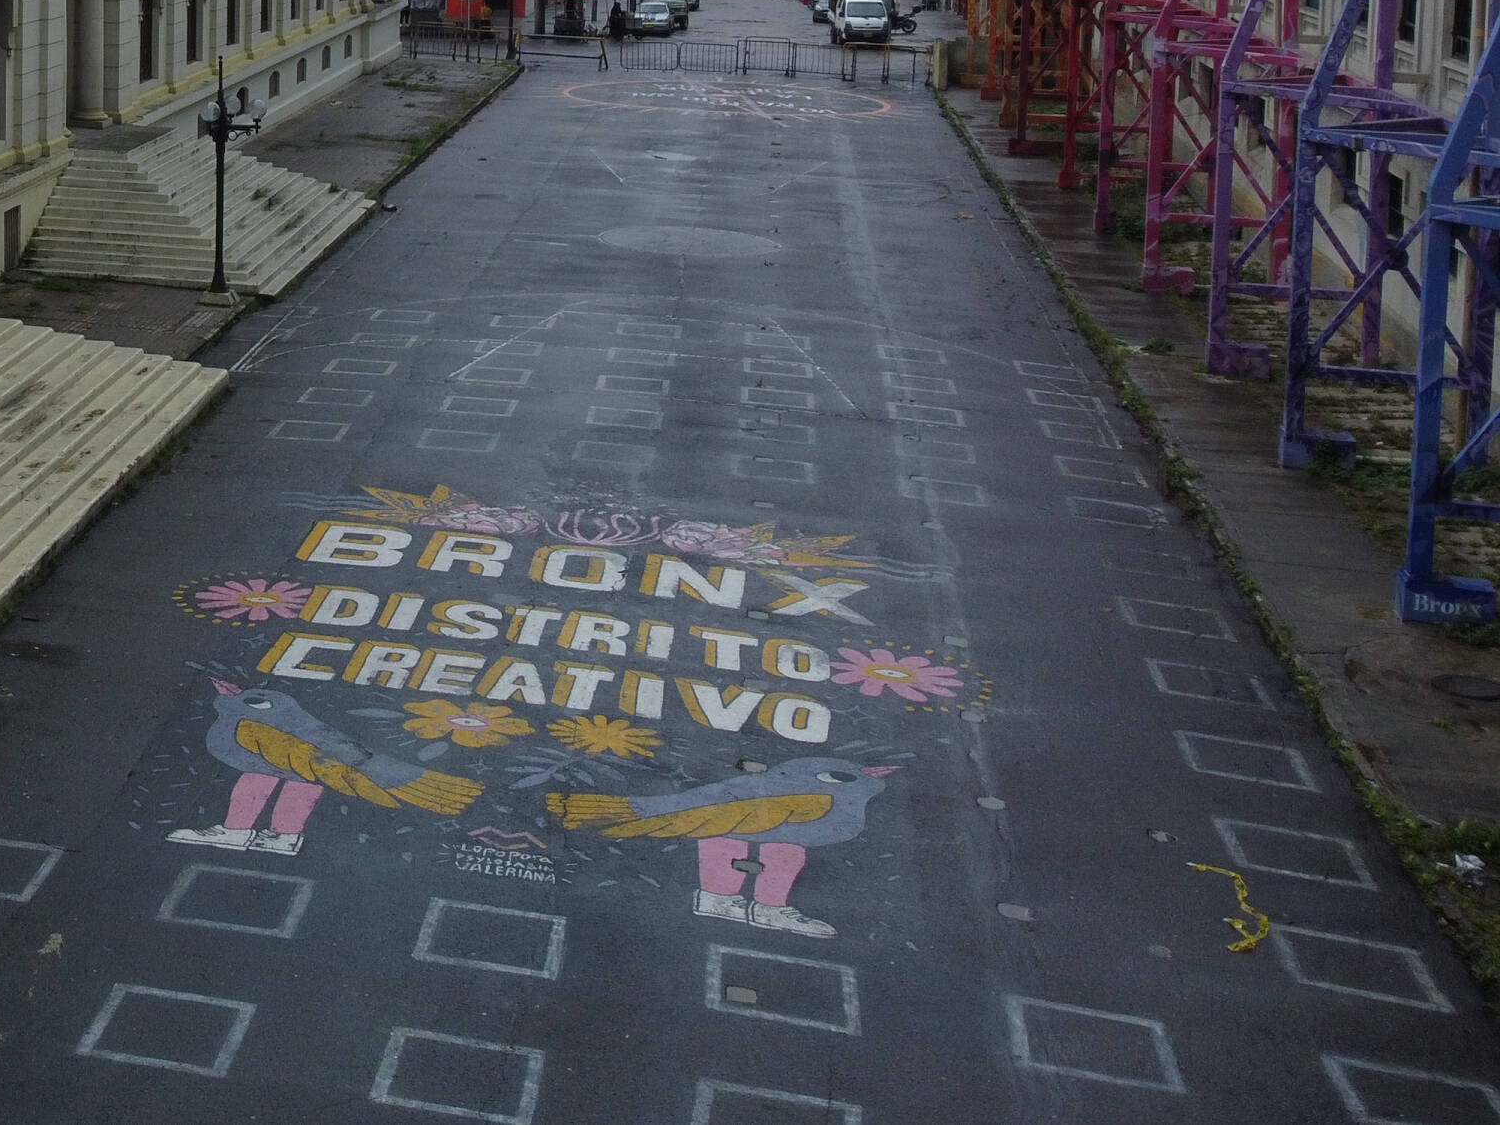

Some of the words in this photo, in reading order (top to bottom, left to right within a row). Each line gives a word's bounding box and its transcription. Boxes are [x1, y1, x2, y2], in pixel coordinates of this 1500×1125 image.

[295, 521, 876, 625] BRONX
[299, 585, 830, 681] DISTRITO
[256, 631, 831, 743] CREATIVO
